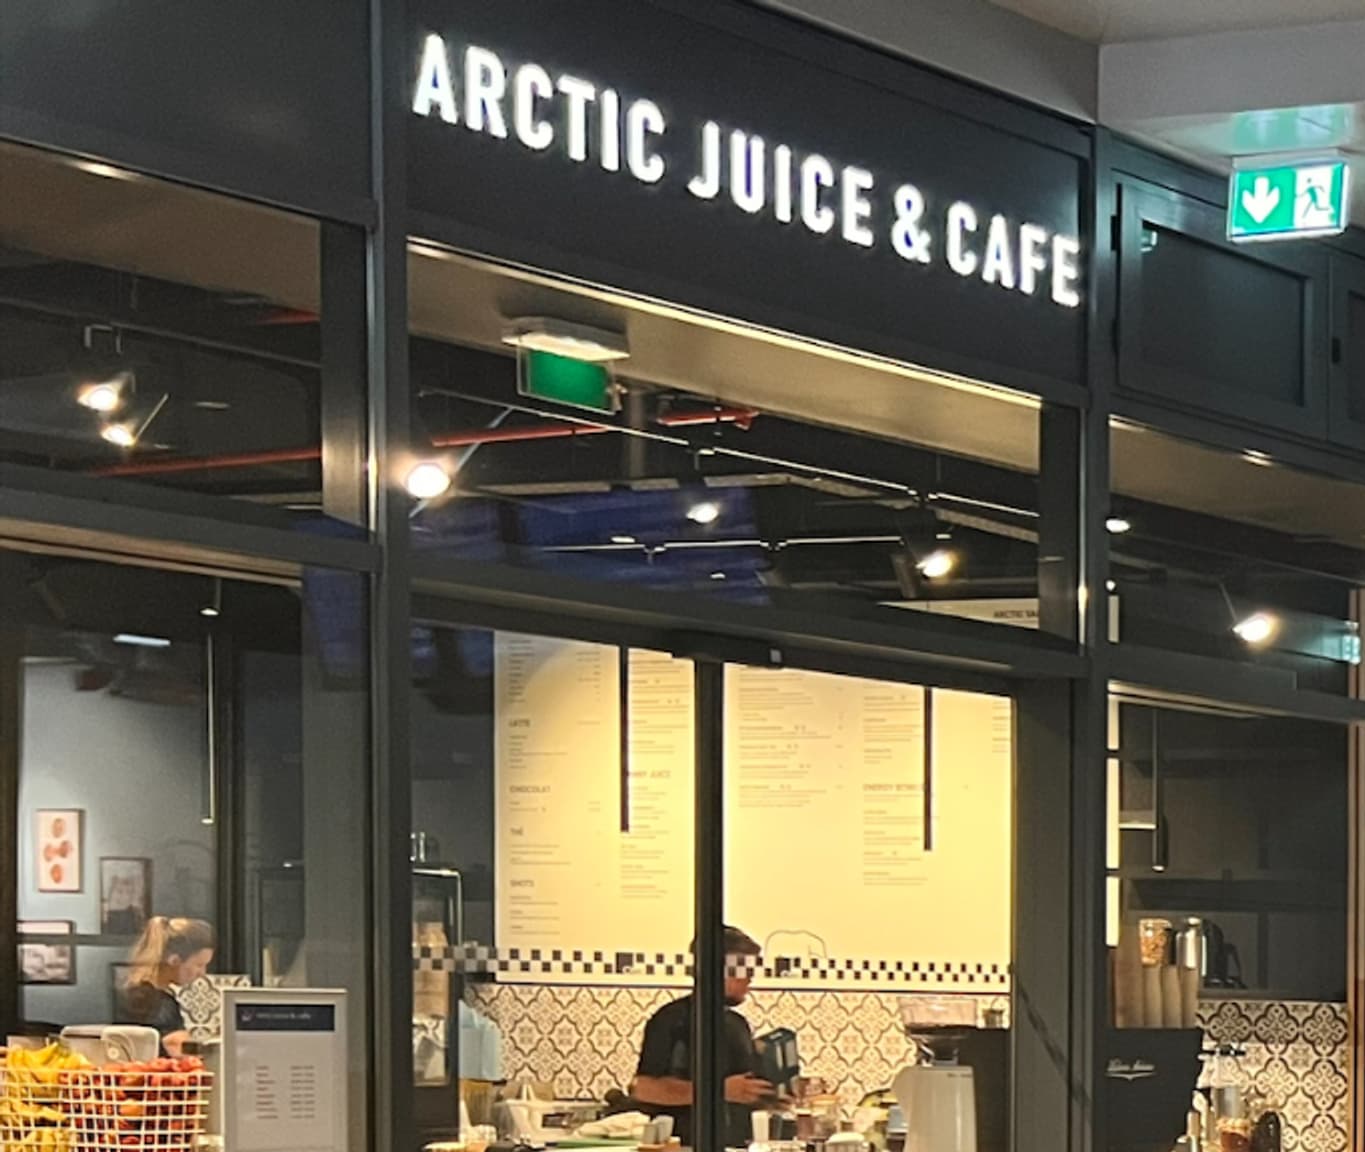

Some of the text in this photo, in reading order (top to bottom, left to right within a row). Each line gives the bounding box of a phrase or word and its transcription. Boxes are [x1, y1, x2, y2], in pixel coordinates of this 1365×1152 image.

[411, 33, 1081, 308] ARCTIC JUICE & CAFE
